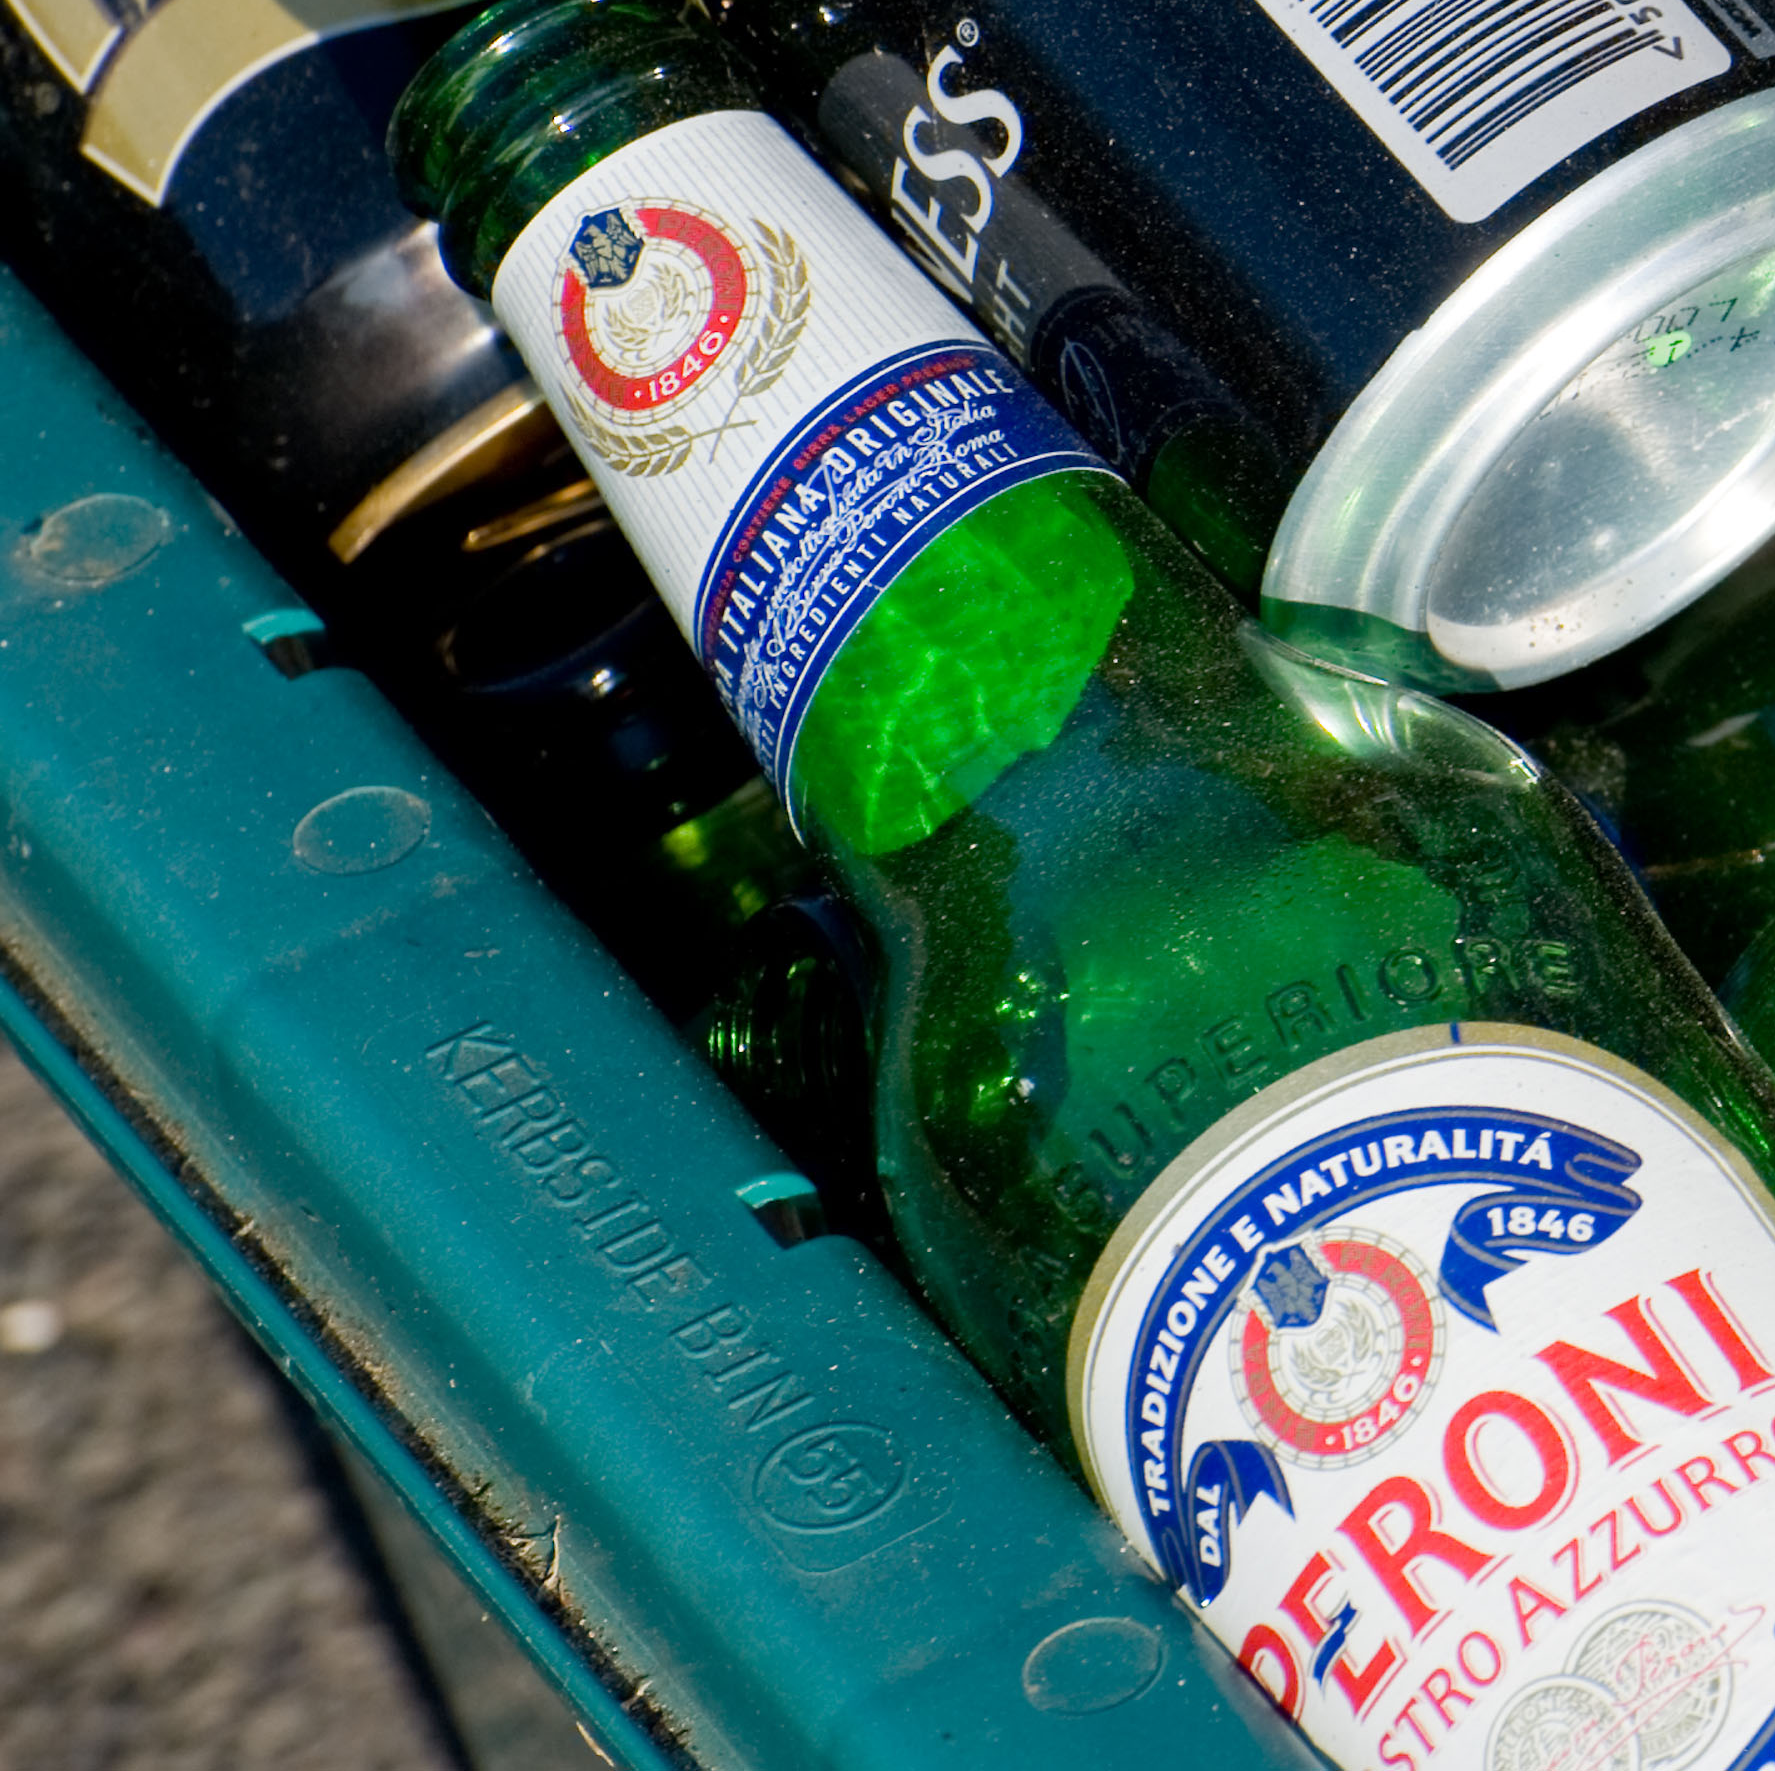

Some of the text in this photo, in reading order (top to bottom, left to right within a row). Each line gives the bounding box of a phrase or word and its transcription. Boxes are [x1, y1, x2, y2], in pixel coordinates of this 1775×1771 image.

[645, 328, 727, 403] 1846
[718, 482, 828, 653] ITALIANA
[826, 367, 1015, 477] ORIGINALE
[769, 532, 889, 711] INGREDIENTI
[891, 445, 1021, 527] NATURALI
[424, 1019, 713, 1312] KERBSIDE
[668, 1302, 817, 1434] BIN
[1228, 1215, 1265, 1252] E
[1485, 1205, 1597, 1243] 1846
[1147, 1243, 1241, 1518] TRADIZIONE
[1341, 1372, 1423, 1450] 1846
[1197, 1481, 1225, 1569] DAL
